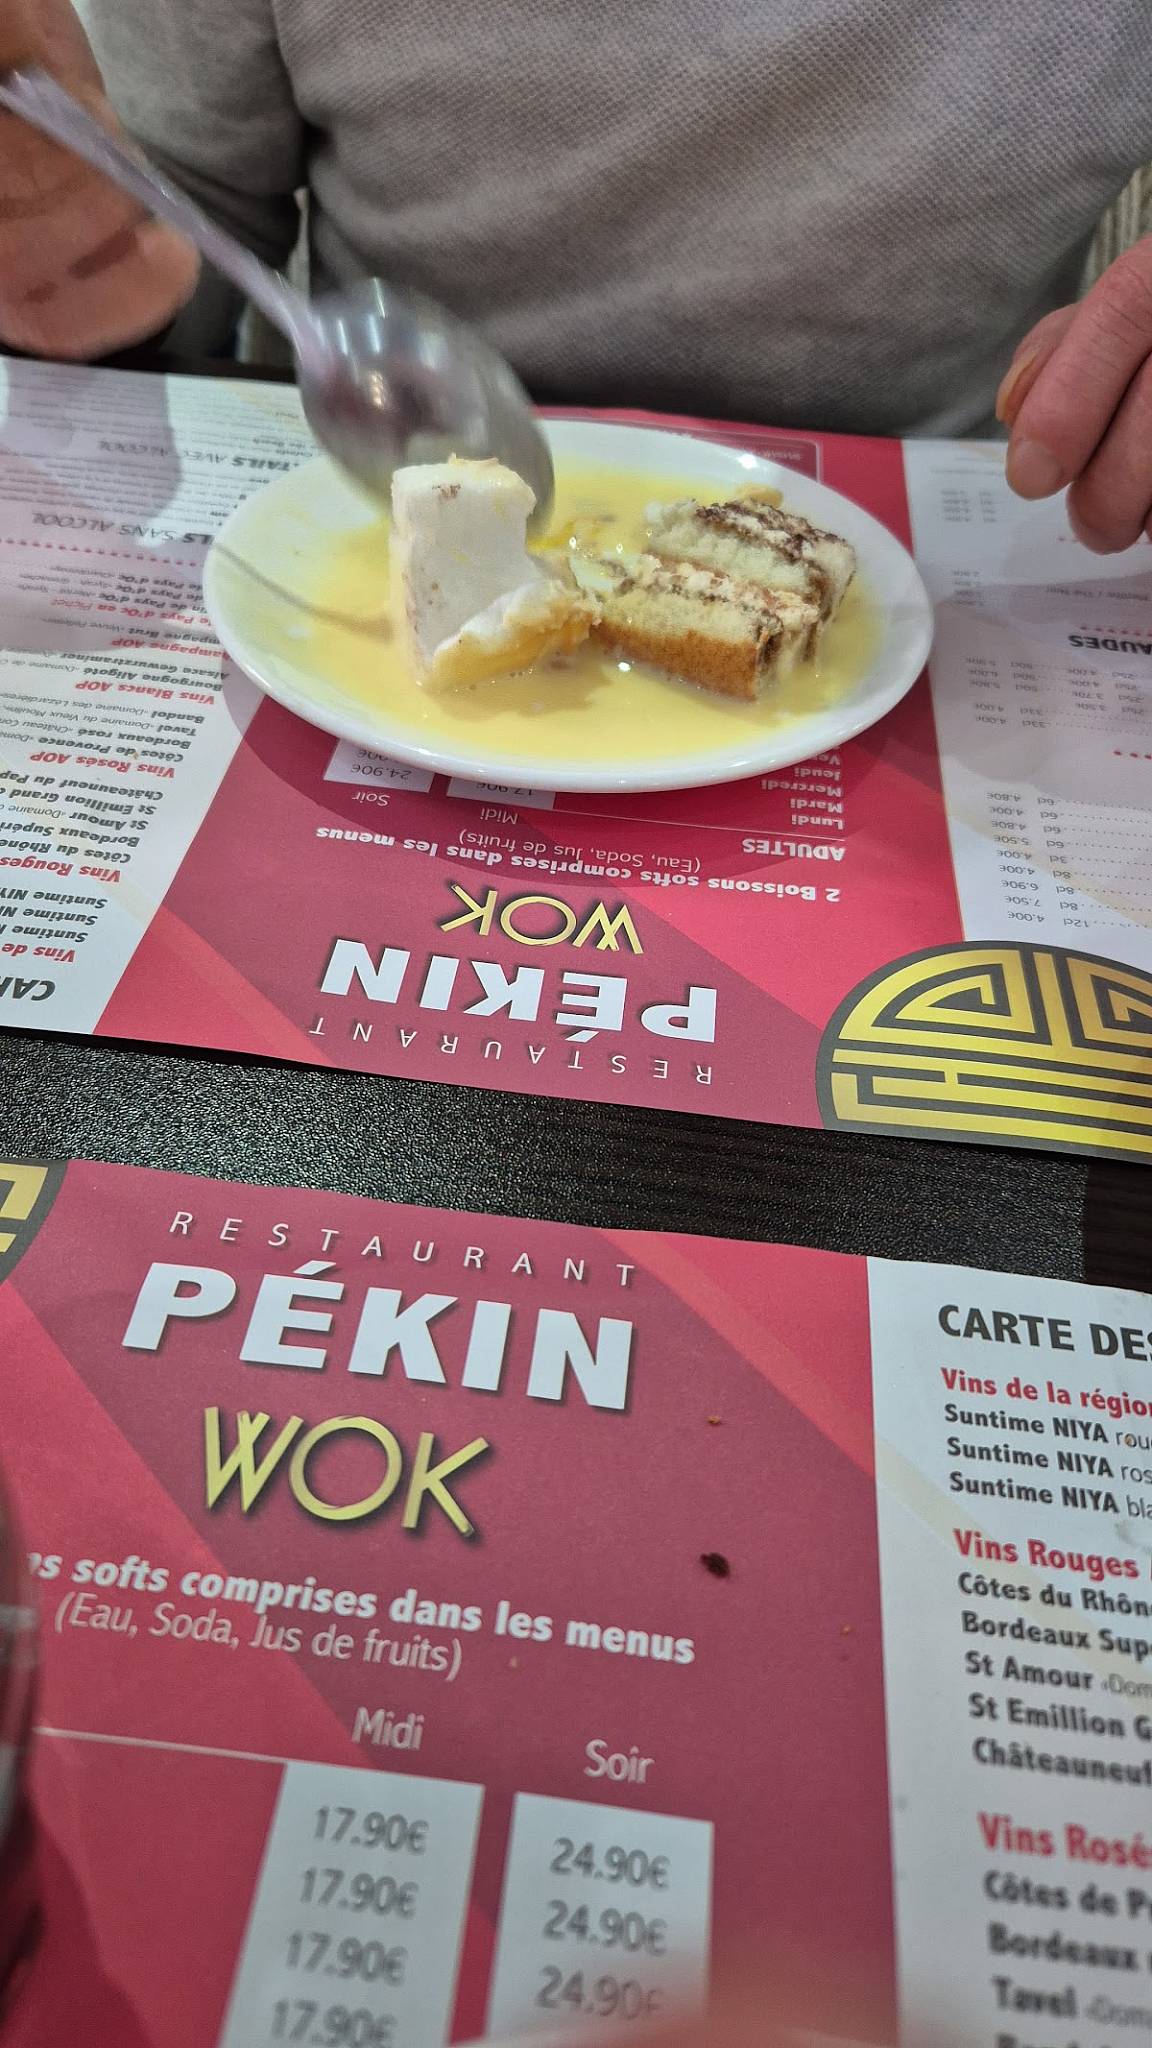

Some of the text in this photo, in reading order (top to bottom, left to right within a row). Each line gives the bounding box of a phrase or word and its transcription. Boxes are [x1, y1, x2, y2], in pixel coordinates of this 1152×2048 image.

[32, 512, 177, 541] SANS ALCOOL
[98, 594, 188, 611] de Pays d'Oc
[150, 589, 182, 600] Pays
[97, 604, 194, 625] Pays d'Oc en
[111, 639, 146, 649] AOP
[128, 628, 160, 639] Brut
[1068, 635, 1152, 656] AUDES
[60, 653, 230, 680] Alsace Gewurztraminer
[83, 667, 222, 692] Bourgogne Aligoté
[75, 681, 215, 706] Vins Blancs AOP
[72, 701, 93, 711] des
[48, 711, 79, 723] Vieux
[83, 716, 98, 725] du
[150, 711, 206, 725] Bandol
[77, 728, 113, 740] rosé
[156, 724, 197, 737] Tavel
[37, 737, 184, 763] Côtes de Provence
[117, 733, 192, 750] Bordeaux
[29, 751, 176, 779] Vins Rosés AOP
[350, 764, 412, 781] 24.90€
[794, 767, 842, 781] Jeudi
[33, 775, 56, 787] du
[59, 780, 164, 801] Châteauneuf
[761, 780, 842, 798] Mercredi
[8, 788, 157, 815] St Emillion Grand
[351, 791, 518, 825] Midi Soir
[790, 798, 844, 814] Mardi
[986, 792, 1054, 806] 6cl 4.80€
[69, 812, 127, 831] Amour
[791, 815, 844, 830] Lundi
[989, 807, 1058, 820] 6cl 4.00€
[130, 820, 149, 830] St
[991, 820, 1061, 834] 6cl 4.80€
[58, 828, 140, 848] Bordeaux
[993, 835, 1064, 849] 6cl 5.50€
[56, 844, 79, 857] du
[84, 849, 132, 864] Côtes
[458, 829, 701, 873] (Eau, Soda, Jus de fruits)
[742, 839, 846, 861] ADULTES
[996, 850, 1068, 864] 3cl 4.00€
[0, 856, 121, 882] Vins Rouges
[316, 827, 841, 902] 2 Boissons softs comprises dans les menus
[998, 865, 1071, 879] 8cl 4.00€
[1000, 880, 1075, 895] 8cl 6.90€
[33, 891, 108, 909] Suntime
[1004, 895, 1078, 911] 8cl 7.50€
[22, 908, 98, 926] Suntime
[440, 885, 643, 954] WOK
[1007, 911, 1089, 928] 12cl 4.00€
[11, 925, 88, 943] Suntime
[1, 943, 76, 963] Vins de
[319, 939, 717, 1043] PÉKIN
[308, 1017, 713, 1085] RESTAURANT
[169, 1211, 635, 1286] RESTAURANT
[121, 1260, 633, 1410] PÉKIN
[938, 1304, 1075, 1352] CARTE
[940, 1367, 997, 1396] Vins
[1006, 1377, 1038, 1401] de
[1046, 1381, 1071, 1405] la
[944, 1403, 1109, 1443] Suntime NIYA
[946, 1436, 1049, 1468] Suntime
[1057, 1450, 1114, 1478] NIYA
[204, 1406, 489, 1536] WOK
[949, 1470, 1053, 1504] Suntime
[1061, 1485, 1120, 1513] NIYA
[953, 1528, 1019, 1562] Vins
[1027, 1538, 1140, 1581] Rouges
[957, 1571, 1032, 1602] Côtes
[1040, 1583, 1073, 1609] du
[70, 1555, 169, 1592] softs
[179, 1571, 377, 1618] comprises
[389, 1588, 482, 1632] dans
[494, 1600, 553, 1642] les
[565, 1619, 695, 1664] menus
[54, 1591, 462, 1681] (Eau, Soda, Jus de fruits)
[961, 1609, 1092, 1650] Bordeaux
[964, 1650, 1094, 1690] St Amour
[968, 1692, 999, 1721] St
[1006, 1697, 1125, 1738] Emillion
[351, 1706, 655, 1784] Midi Soir
[314, 1805, 430, 1855] 17.90€
[976, 1810, 1056, 1857] Vins
[549, 1836, 671, 1892] 24.90€
[300, 1866, 420, 1920] 17.90€
[983, 1869, 1119, 1917] Côtes de
[542, 1899, 668, 1957] 24.90€
[286, 1929, 410, 1987] 17.90€
